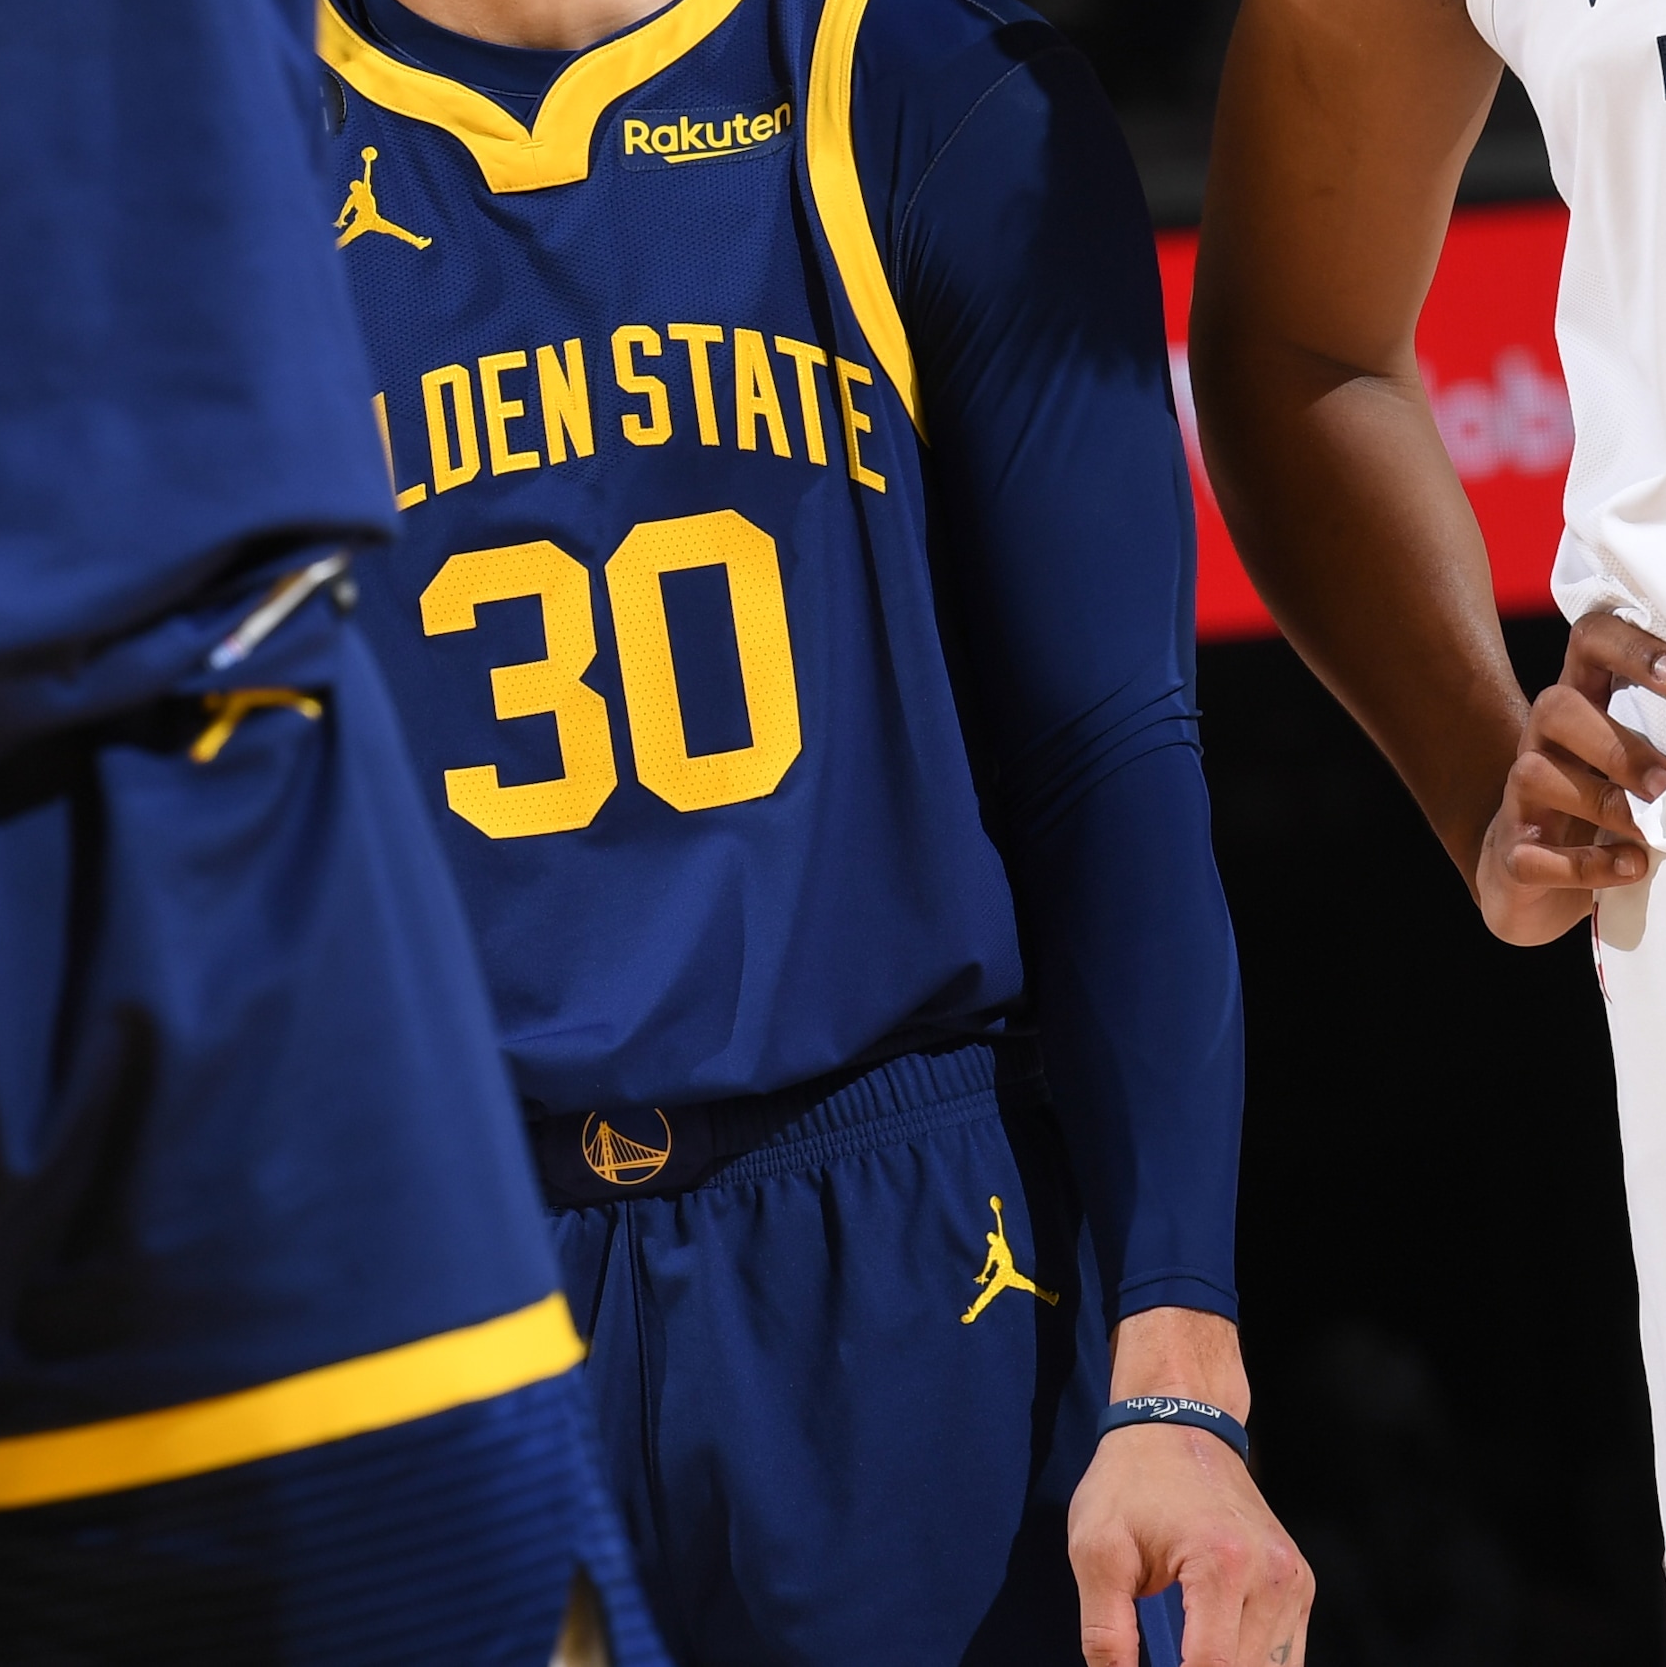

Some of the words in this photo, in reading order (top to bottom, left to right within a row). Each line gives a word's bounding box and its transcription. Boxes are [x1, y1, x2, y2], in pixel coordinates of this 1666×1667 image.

[622, 99, 792, 164] Rakuten
[609, 321, 887, 495] STATE
[418, 508, 804, 841] 30
[1178, 1399, 1222, 1419] ACTIVE
